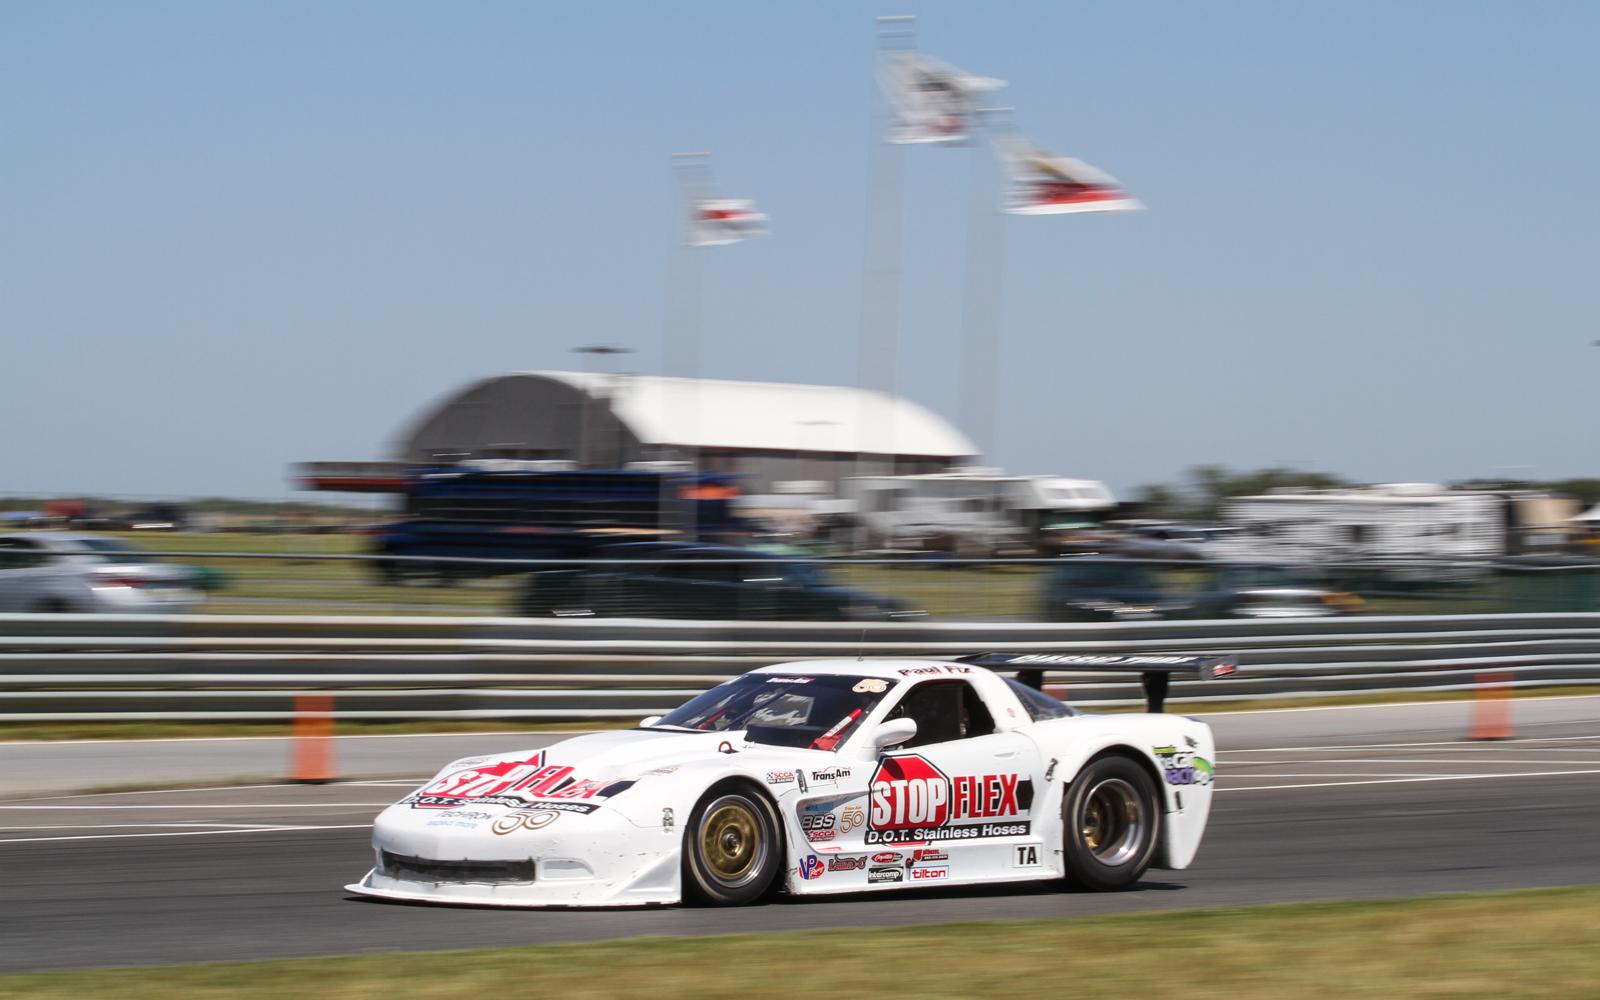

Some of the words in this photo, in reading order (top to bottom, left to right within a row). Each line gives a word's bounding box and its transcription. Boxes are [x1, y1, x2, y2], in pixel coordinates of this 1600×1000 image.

[897, 666, 943, 676] Paul
[872, 777, 946, 827] STOP
[952, 773, 1019, 820] FLEX
[491, 810, 561, 836] 50
[802, 813, 836, 830] BBS
[840, 810, 865, 834] 50
[867, 828, 910, 843] D.O.T.
[913, 825, 979, 841] Stainless
[982, 823, 1027, 836] Hoses
[1017, 846, 1038, 865] TA
[912, 868, 946, 879] tilton
